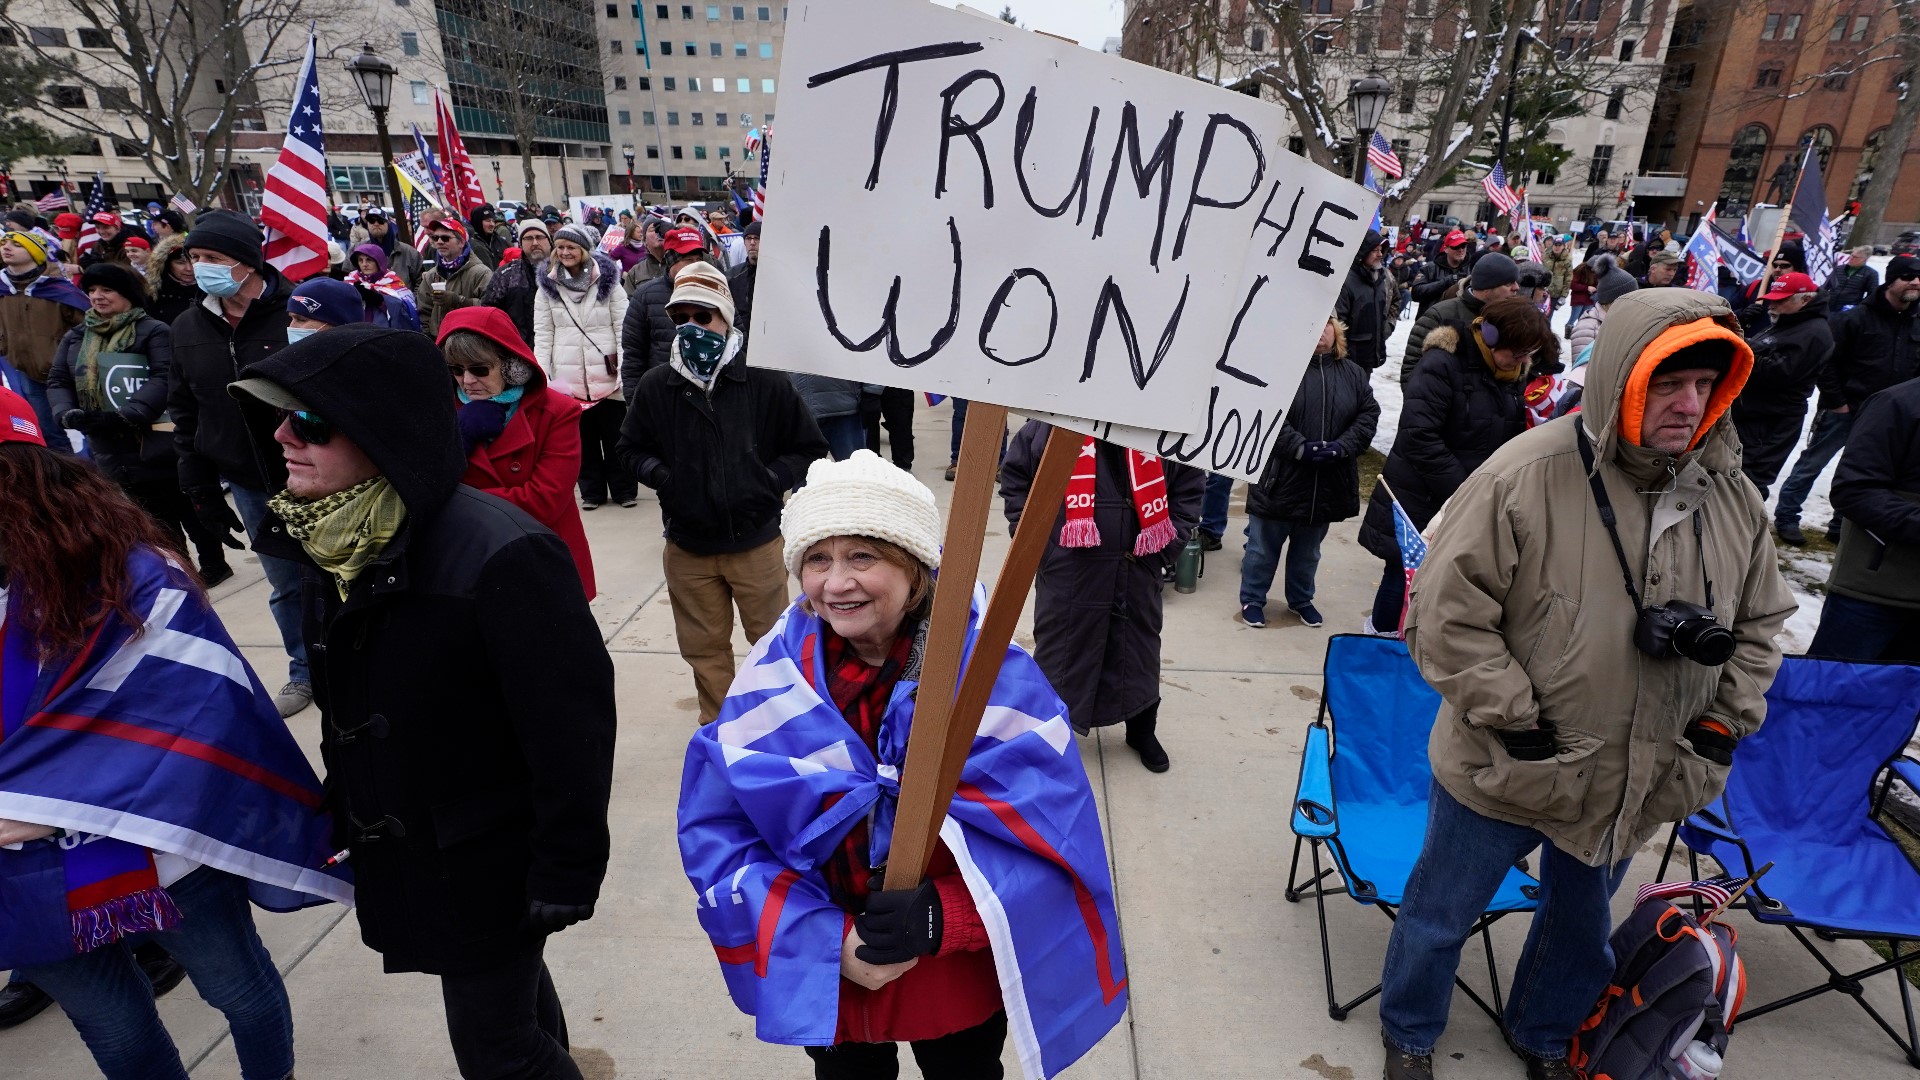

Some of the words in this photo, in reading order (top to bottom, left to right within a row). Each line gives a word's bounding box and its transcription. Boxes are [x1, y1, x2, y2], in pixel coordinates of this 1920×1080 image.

[807, 41, 1266, 273] TRUMP
[602, 234, 624, 246] STOP
[816, 215, 1190, 390] WON
[1157, 386, 1283, 475] WON
